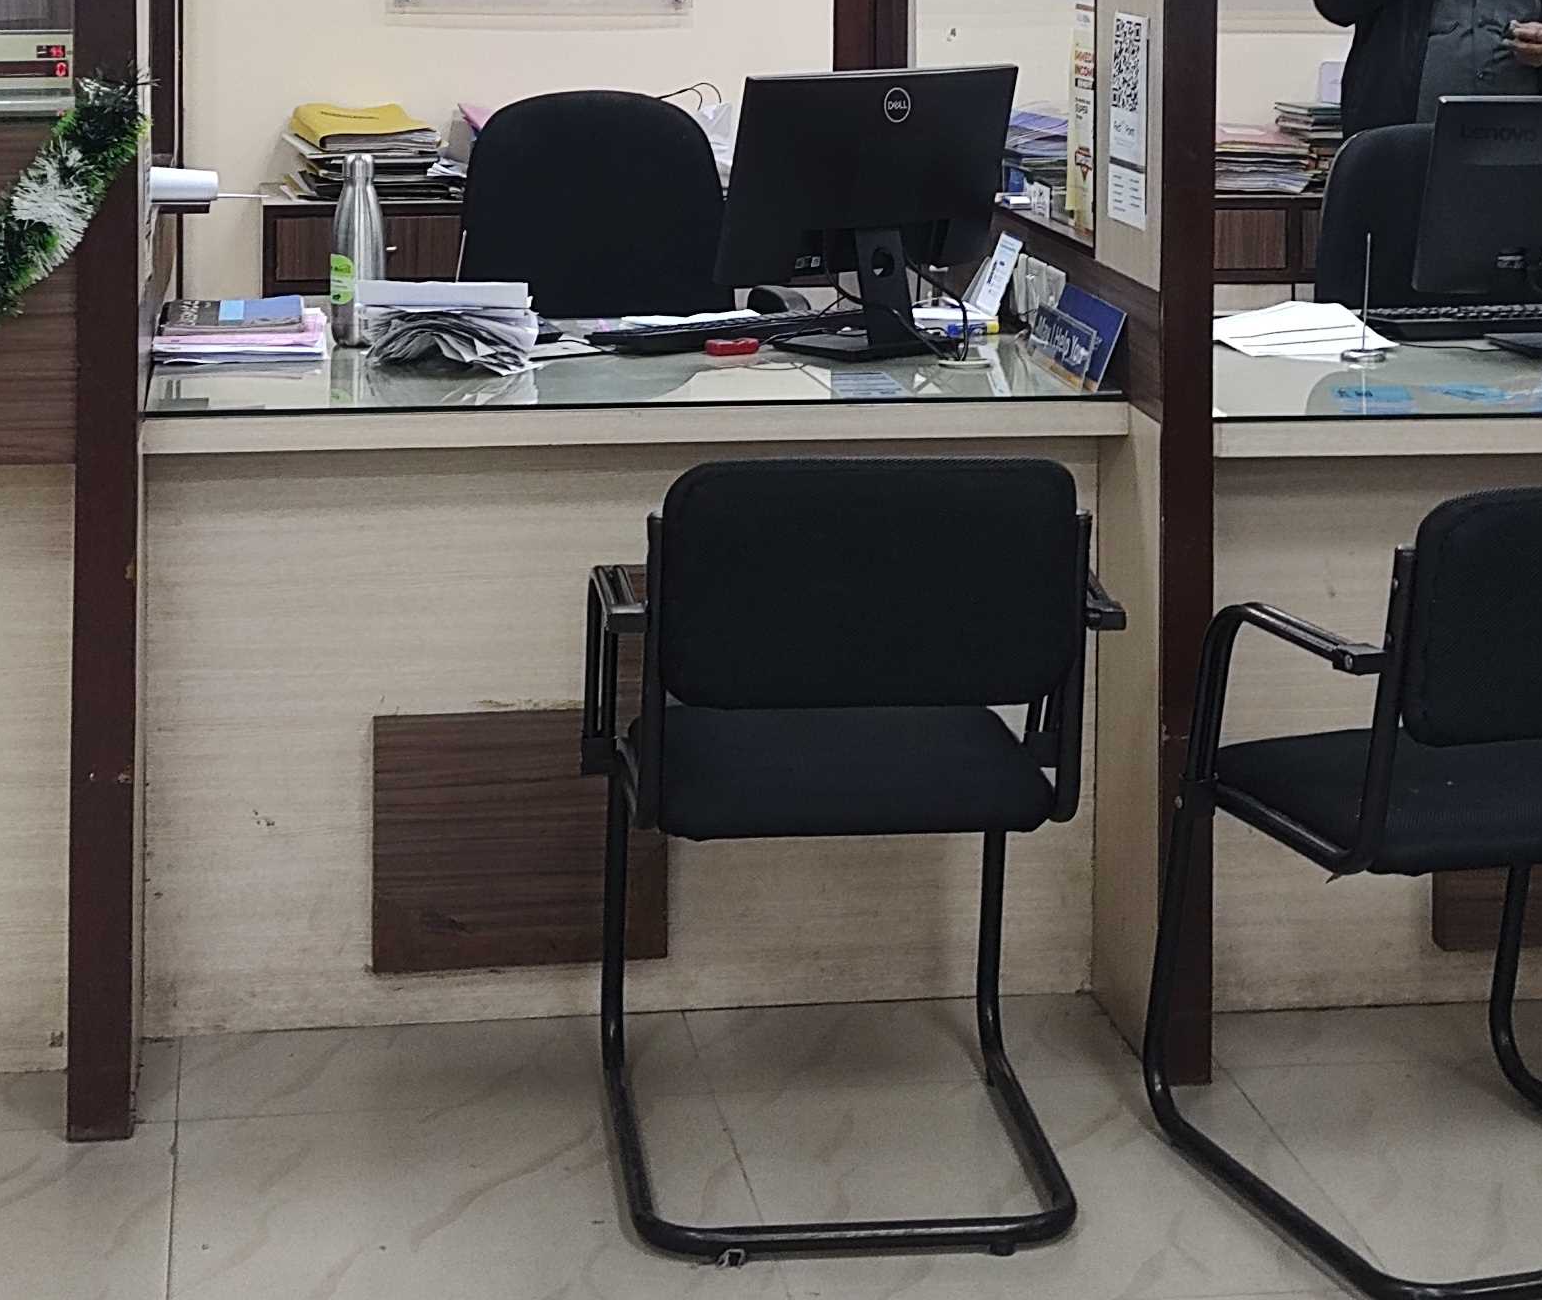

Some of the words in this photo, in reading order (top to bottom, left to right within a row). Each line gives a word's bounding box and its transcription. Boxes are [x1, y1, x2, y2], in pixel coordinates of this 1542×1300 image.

[888, 100, 907, 110] DELL
[1035, 315, 1051, 342] May
[1054, 326, 1071, 361] Help
